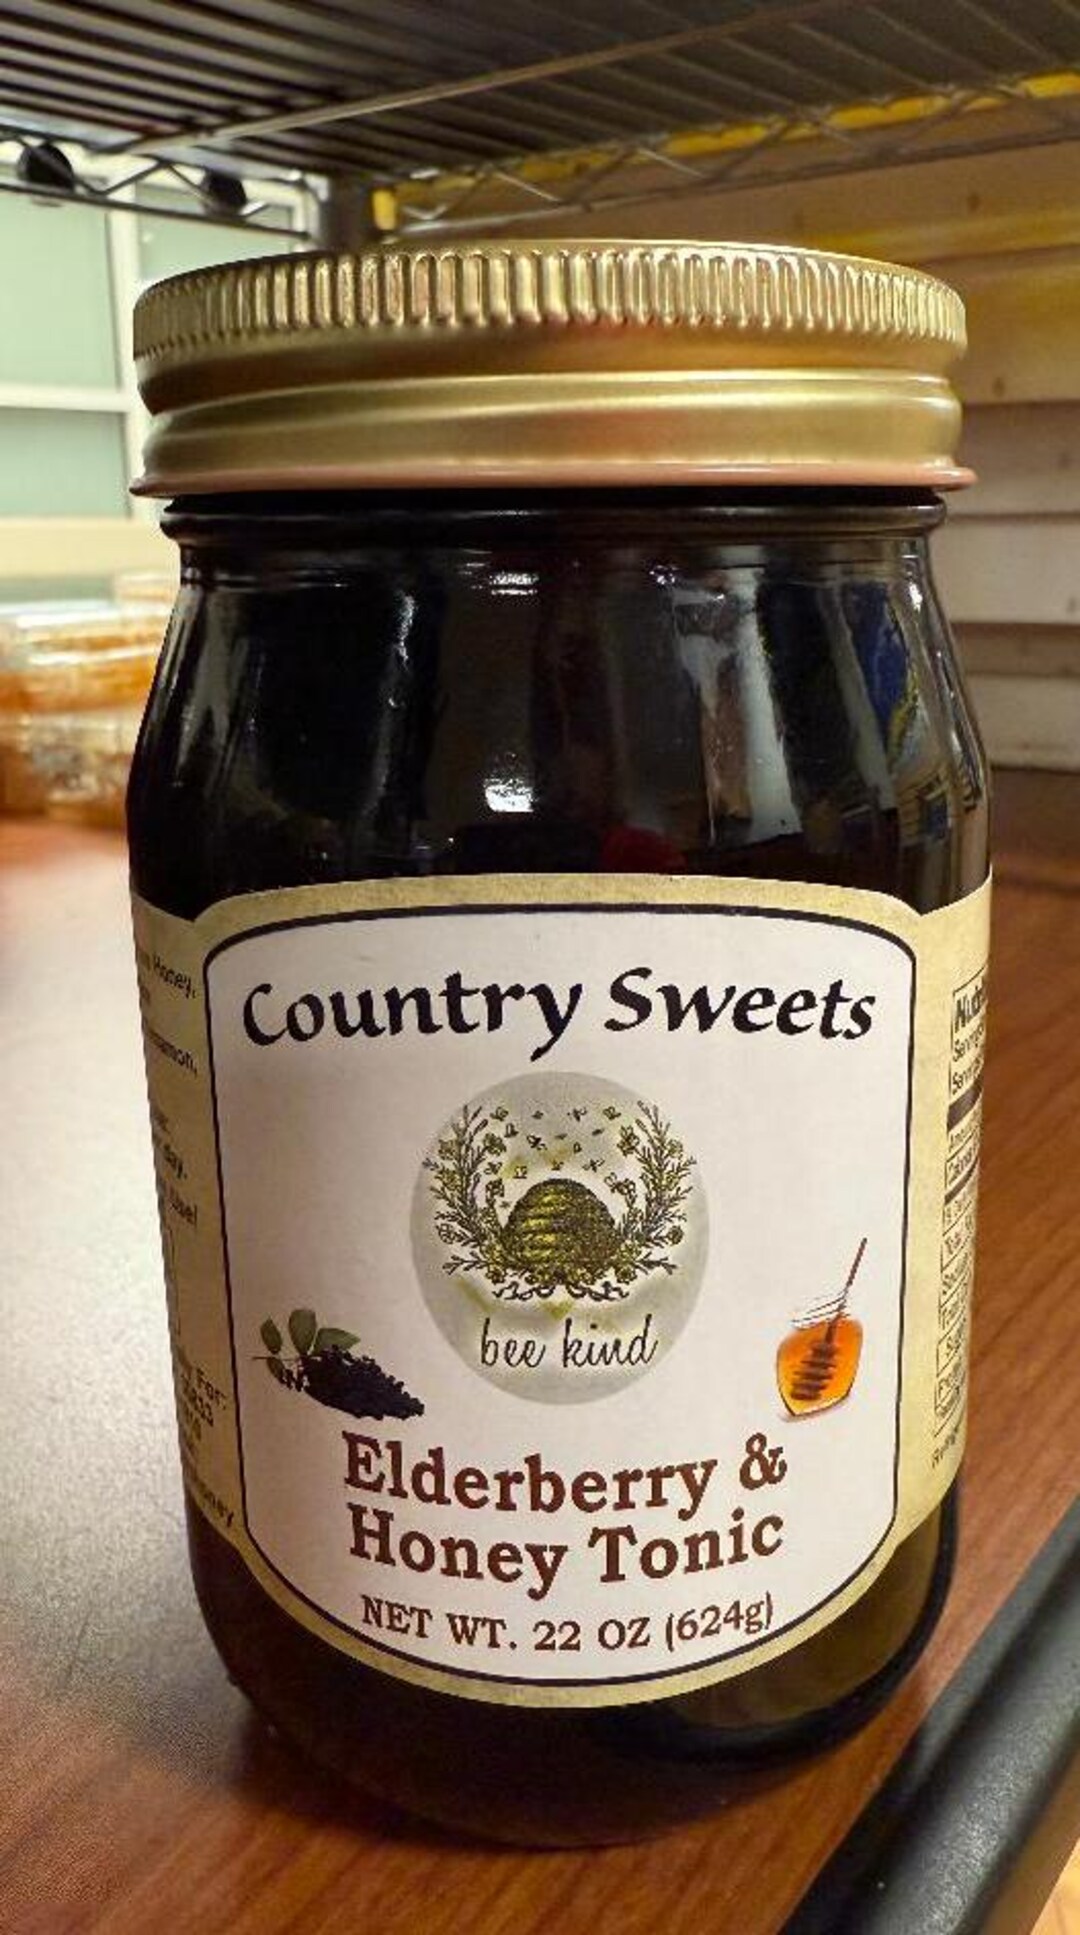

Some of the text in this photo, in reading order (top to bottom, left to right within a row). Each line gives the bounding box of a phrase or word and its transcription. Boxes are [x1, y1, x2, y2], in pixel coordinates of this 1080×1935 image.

[243, 967, 876, 1062] Country Sweets
[480, 1313, 659, 1368] bee kind
[341, 1429, 788, 1522] Elderberry &
[346, 1501, 784, 1602] Honey Tonic
[359, 1591, 774, 1653] NET WT. 22 OZ (624g)
